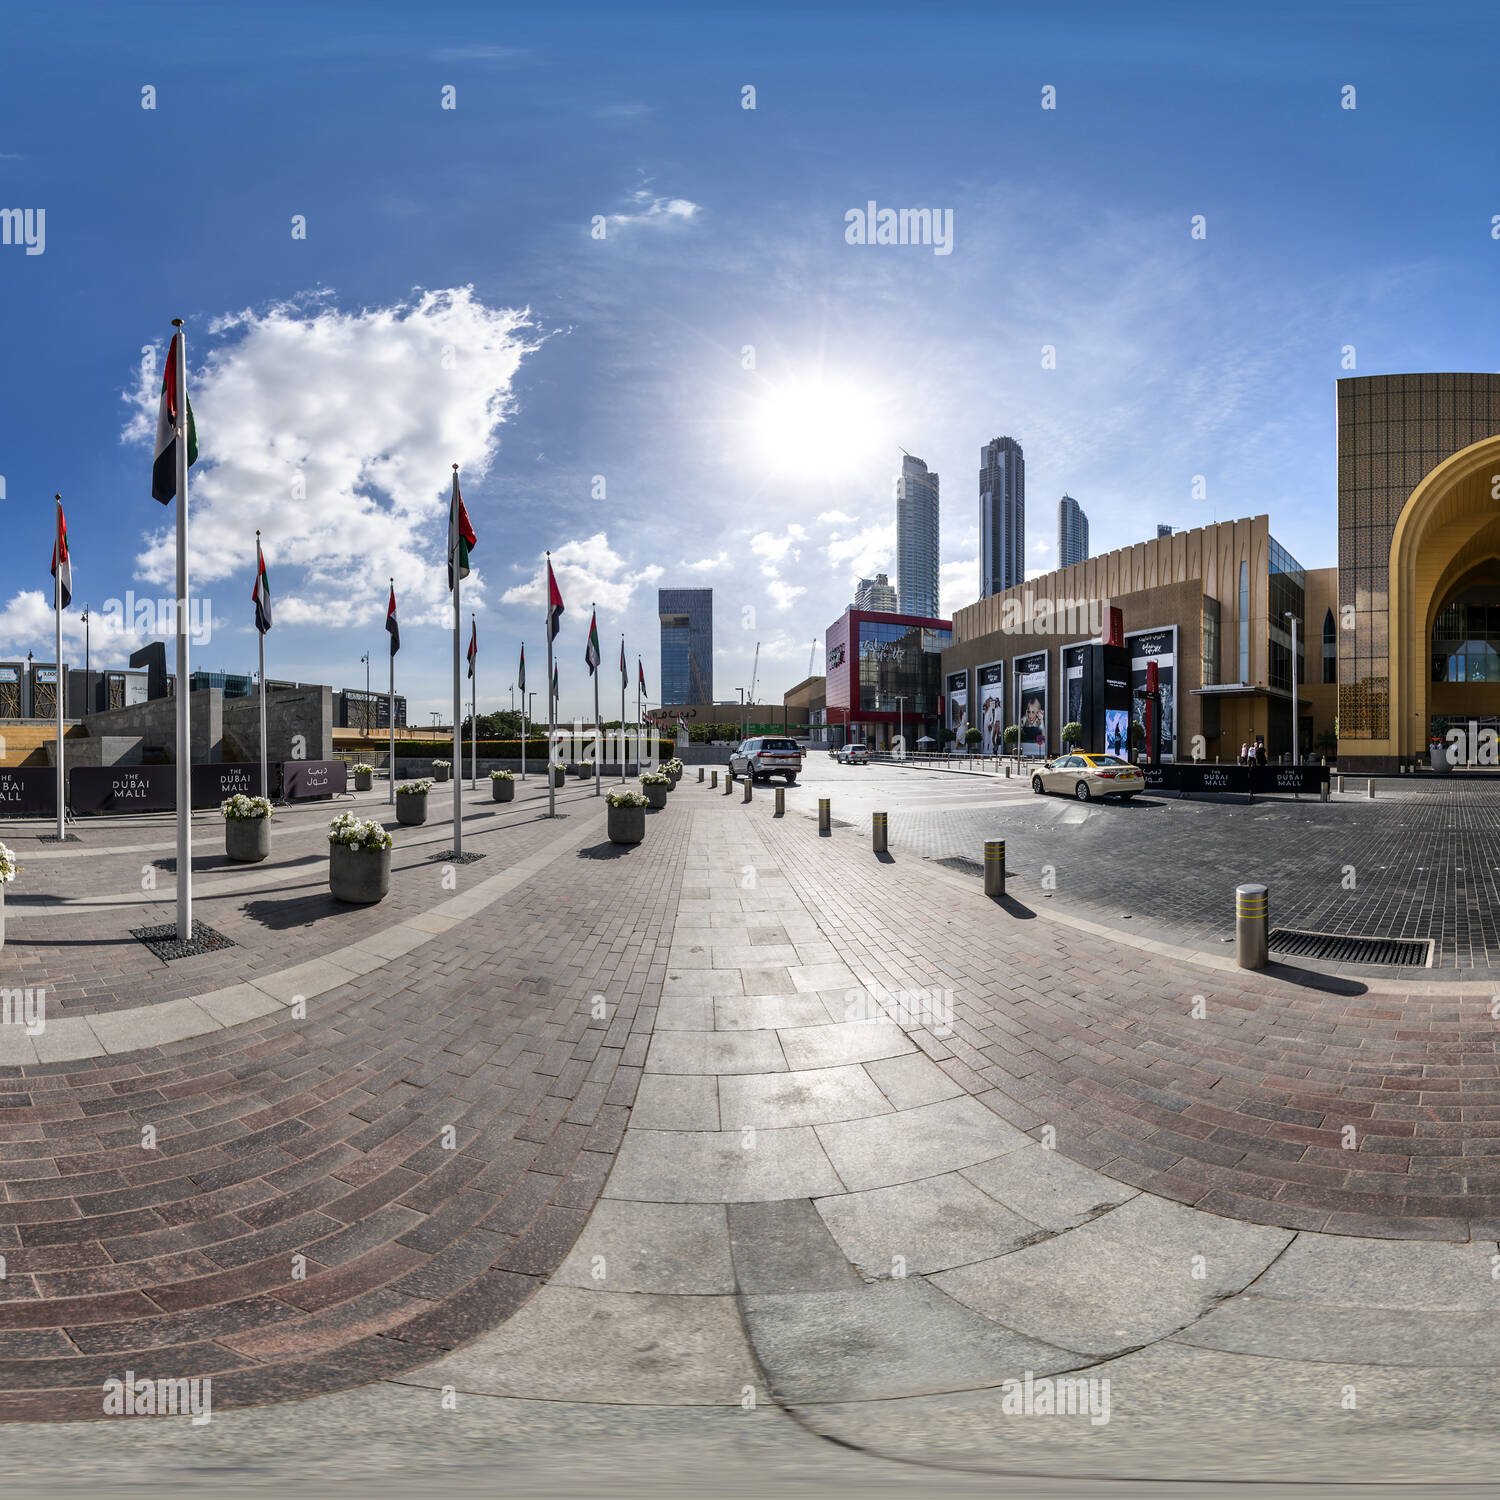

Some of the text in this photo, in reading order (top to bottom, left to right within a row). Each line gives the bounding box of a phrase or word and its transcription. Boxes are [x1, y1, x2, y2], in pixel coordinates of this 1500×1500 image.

[307, 767, 328, 775] دبي
[220, 775, 251, 784] DUBAI
[306, 776, 328, 786] مول
[112, 780, 150, 789] DUBAI
[221, 783, 249, 792] MALL
[114, 789, 147, 798] MALL
